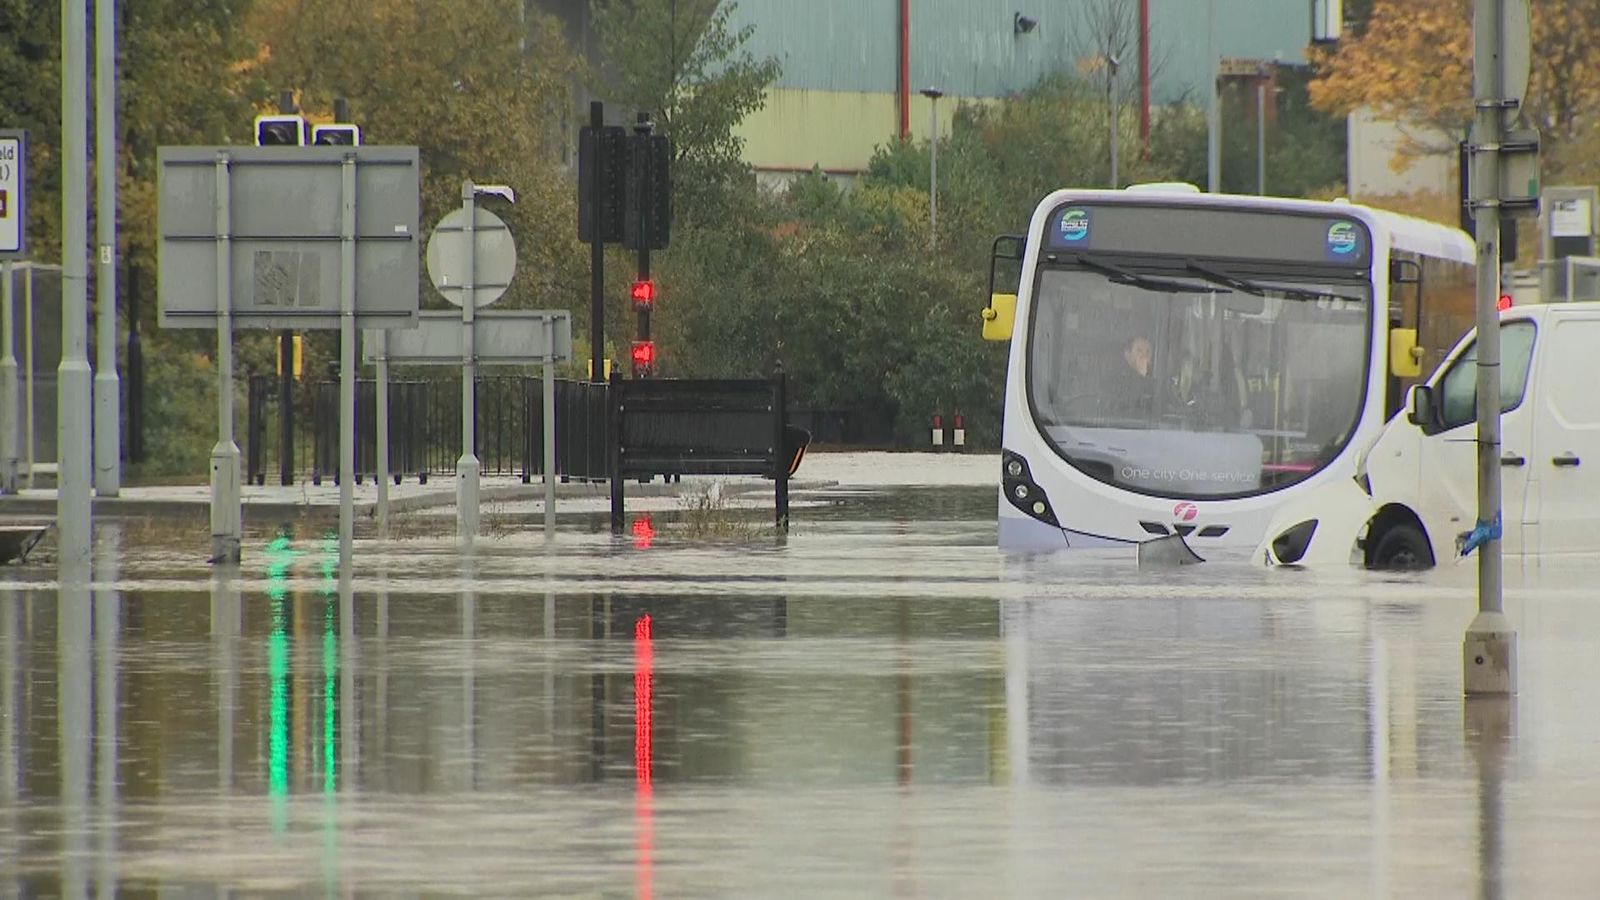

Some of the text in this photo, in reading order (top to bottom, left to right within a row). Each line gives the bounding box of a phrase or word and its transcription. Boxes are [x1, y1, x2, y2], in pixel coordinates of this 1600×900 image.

[1121, 466, 1256, 483] One city One service
